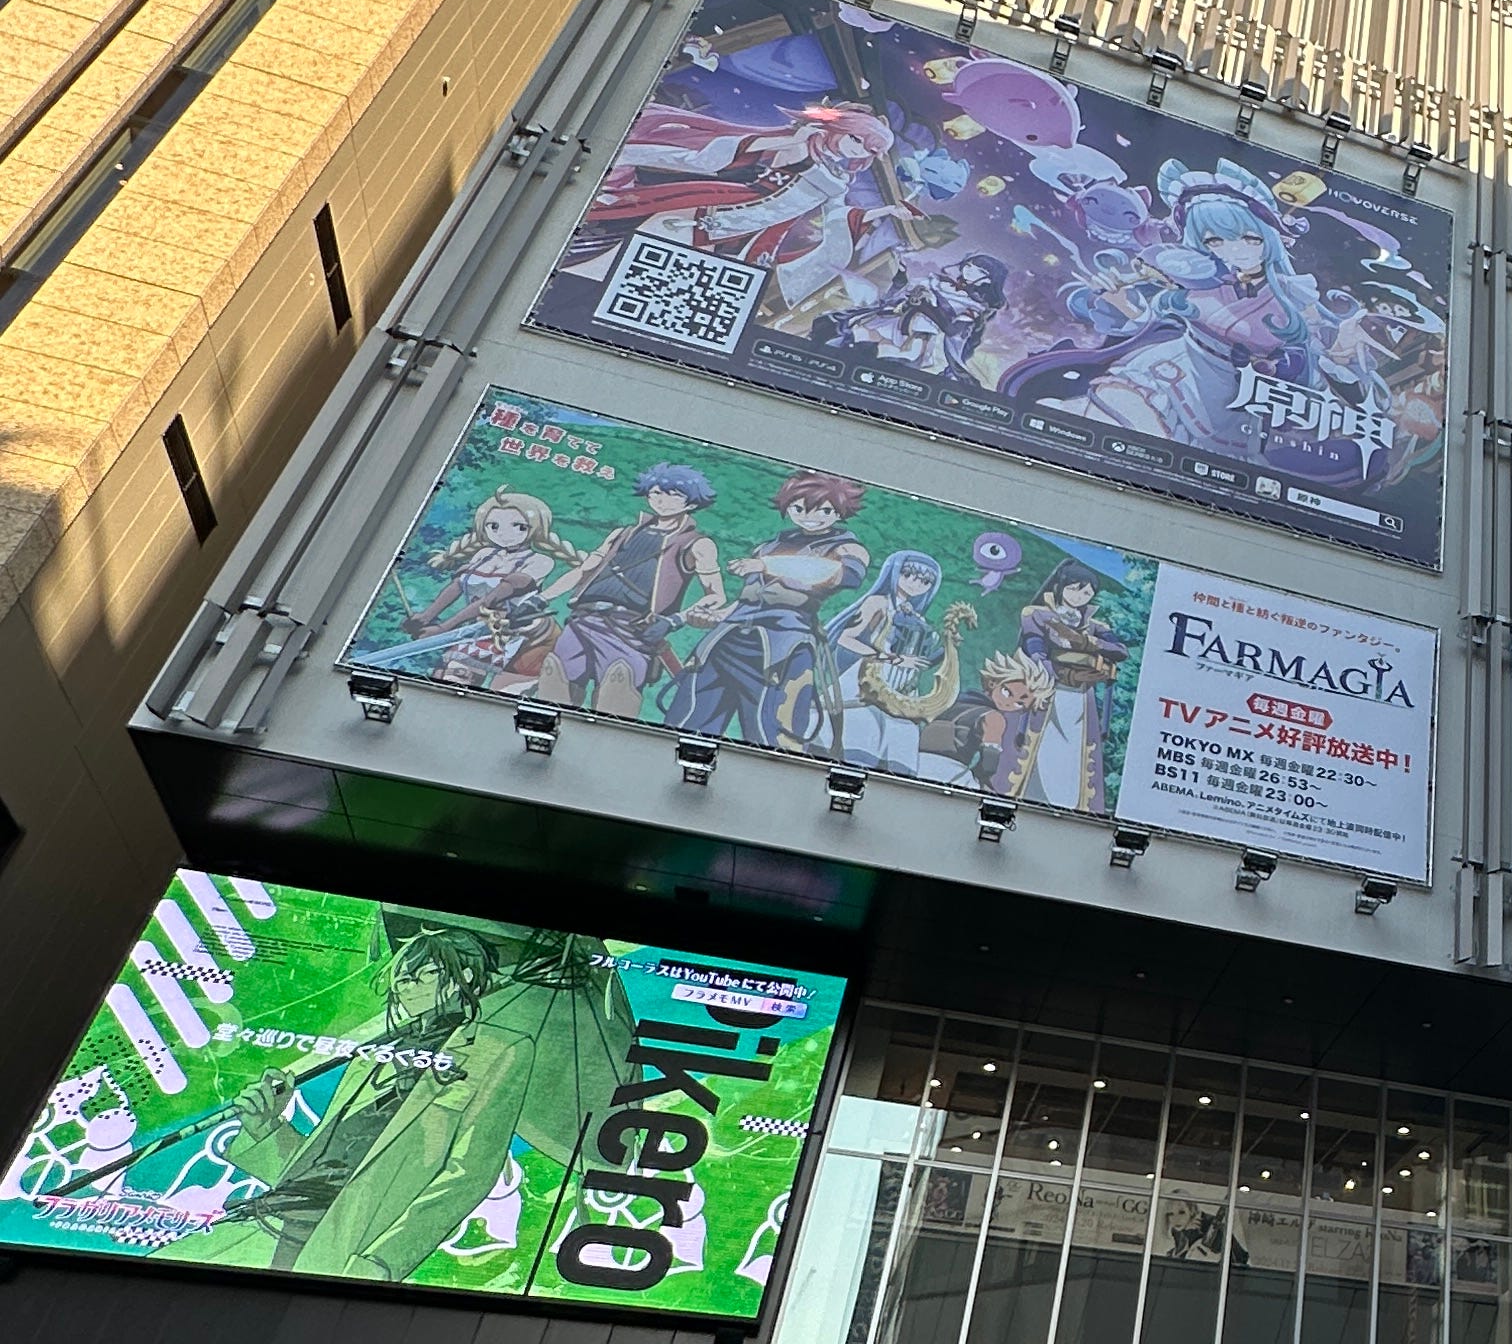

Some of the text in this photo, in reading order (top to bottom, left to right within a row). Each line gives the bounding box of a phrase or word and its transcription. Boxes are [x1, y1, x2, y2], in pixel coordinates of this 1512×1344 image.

[1328, 187, 1419, 226] HOYOVERSE
[1226, 362, 1397, 480] 原神
[498, 437, 615, 480] 世界を救え
[1240, 423, 1340, 461] Genshin
[1164, 611, 1415, 707] FARMAGIA
[1252, 697, 1326, 728] 毎週金曜
[1157, 747, 1196, 766] MBS
[1160, 731, 1222, 755] TOKYO
[1227, 746, 1255, 763] MX
[1154, 763, 1200, 784] BS11
